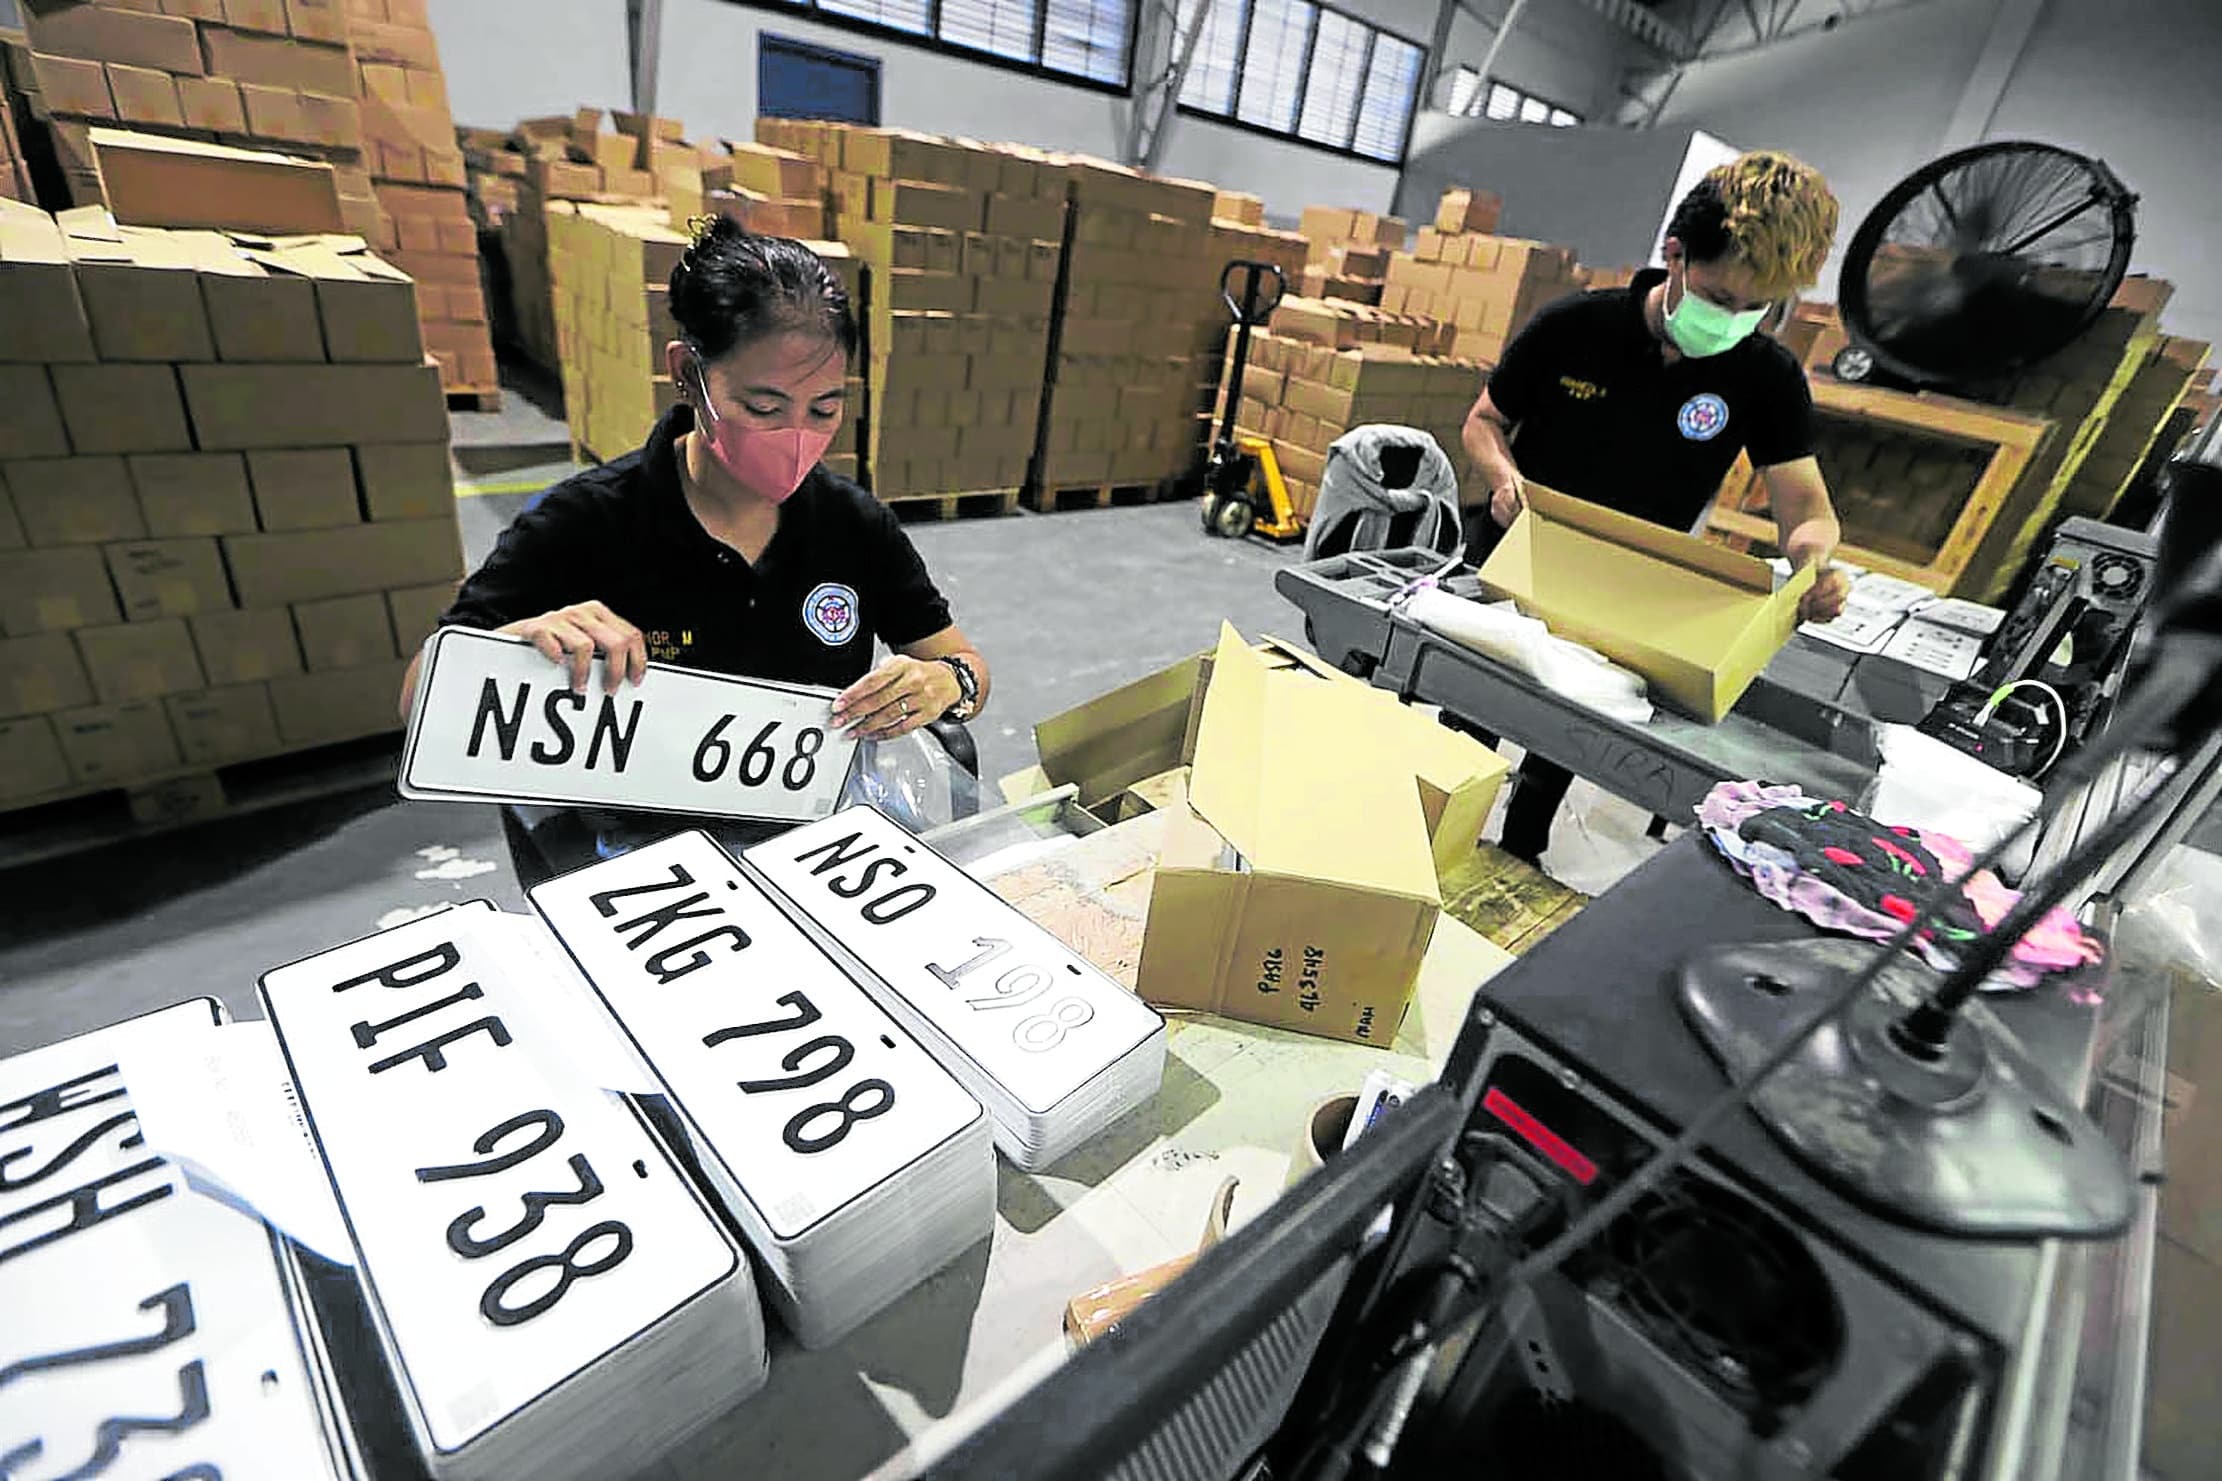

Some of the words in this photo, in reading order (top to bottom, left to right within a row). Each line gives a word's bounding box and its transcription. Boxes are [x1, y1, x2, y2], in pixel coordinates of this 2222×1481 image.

[466, 677, 644, 773] NSN
[692, 713, 825, 791] 668
[332, 941, 513, 1074] PIF
[588, 864, 752, 985] ZKG
[701, 990, 896, 1154] 798
[793, 832, 937, 925] NSO
[924, 936, 1094, 1053] 198
[1257, 947, 1284, 994] PASIG
[414, 1108, 634, 1327] 938
[0, 1281, 224, 1481] 73
